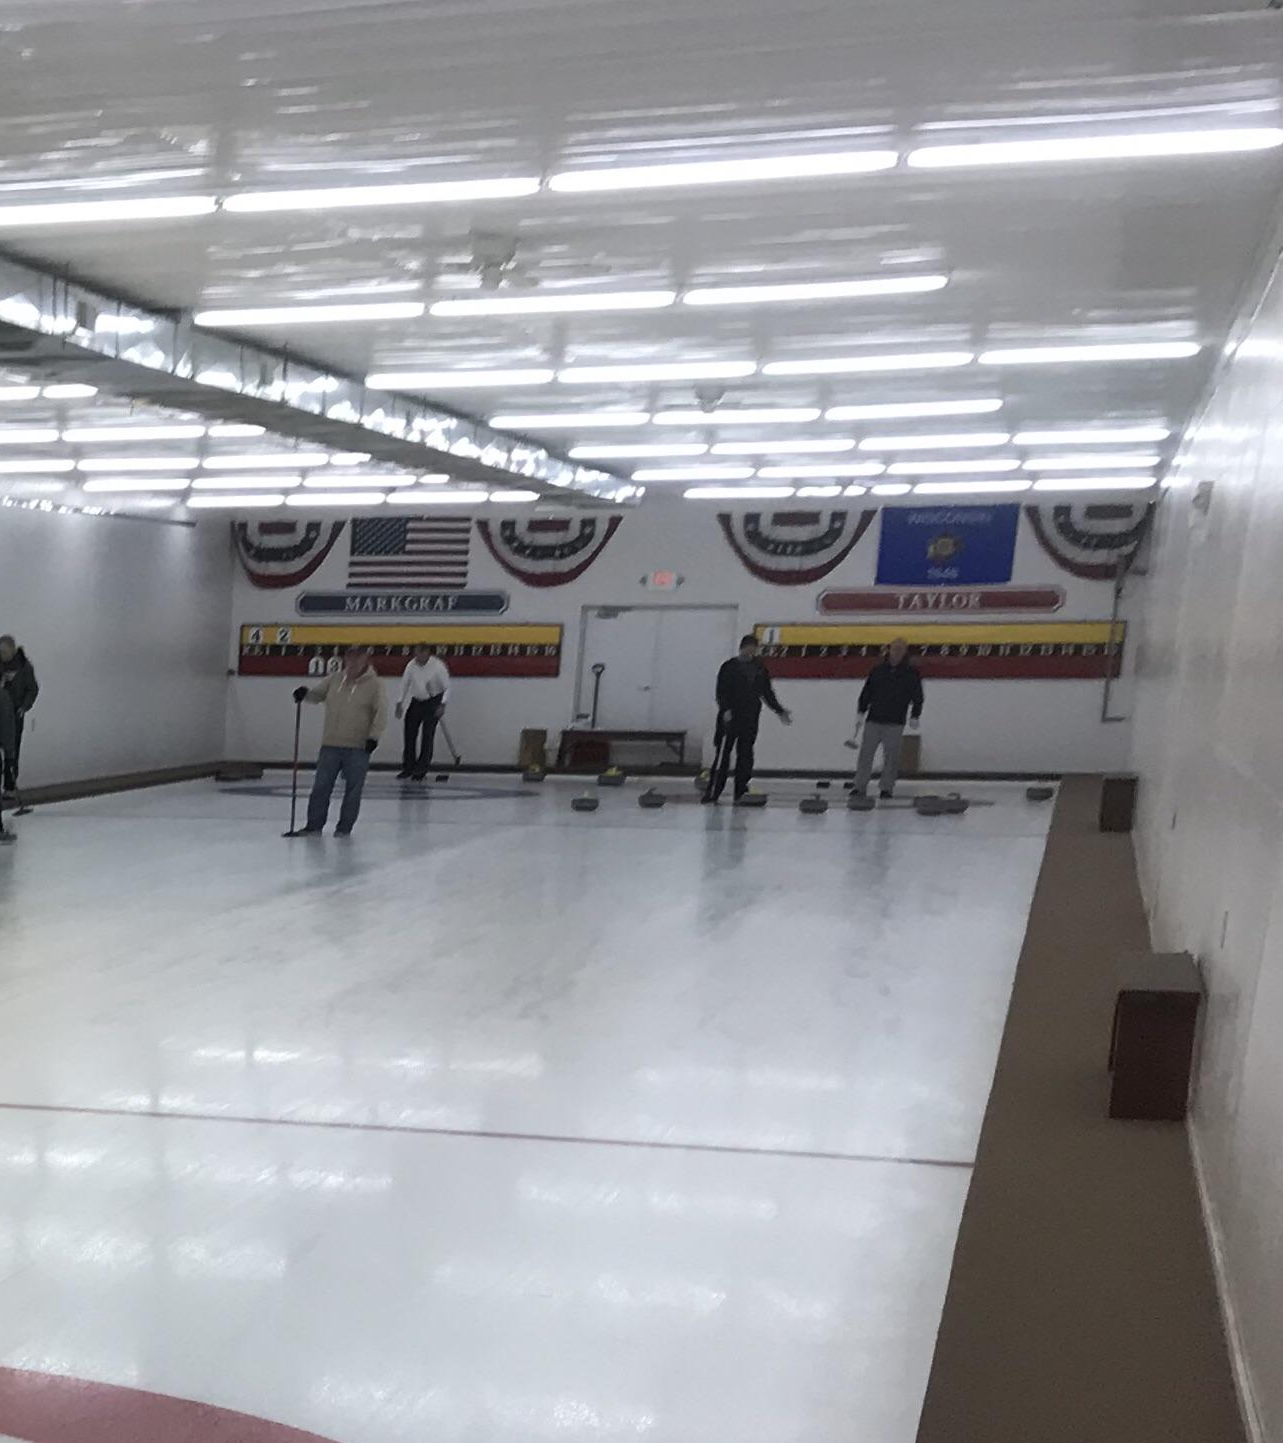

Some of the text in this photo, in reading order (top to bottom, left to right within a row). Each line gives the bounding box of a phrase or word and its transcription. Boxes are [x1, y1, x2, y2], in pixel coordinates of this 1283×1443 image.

[344, 595, 459, 613] MARKGRAF
[895, 592, 983, 610] TAYLOR
[939, 644, 950, 656] 8
[977, 644, 992, 656] 10
[998, 644, 1011, 656] 11
[1020, 644, 1035, 656] 12
[1040, 644, 1054, 656] 13
[1060, 644, 1075, 656] 14
[1082, 644, 1096, 656] 15
